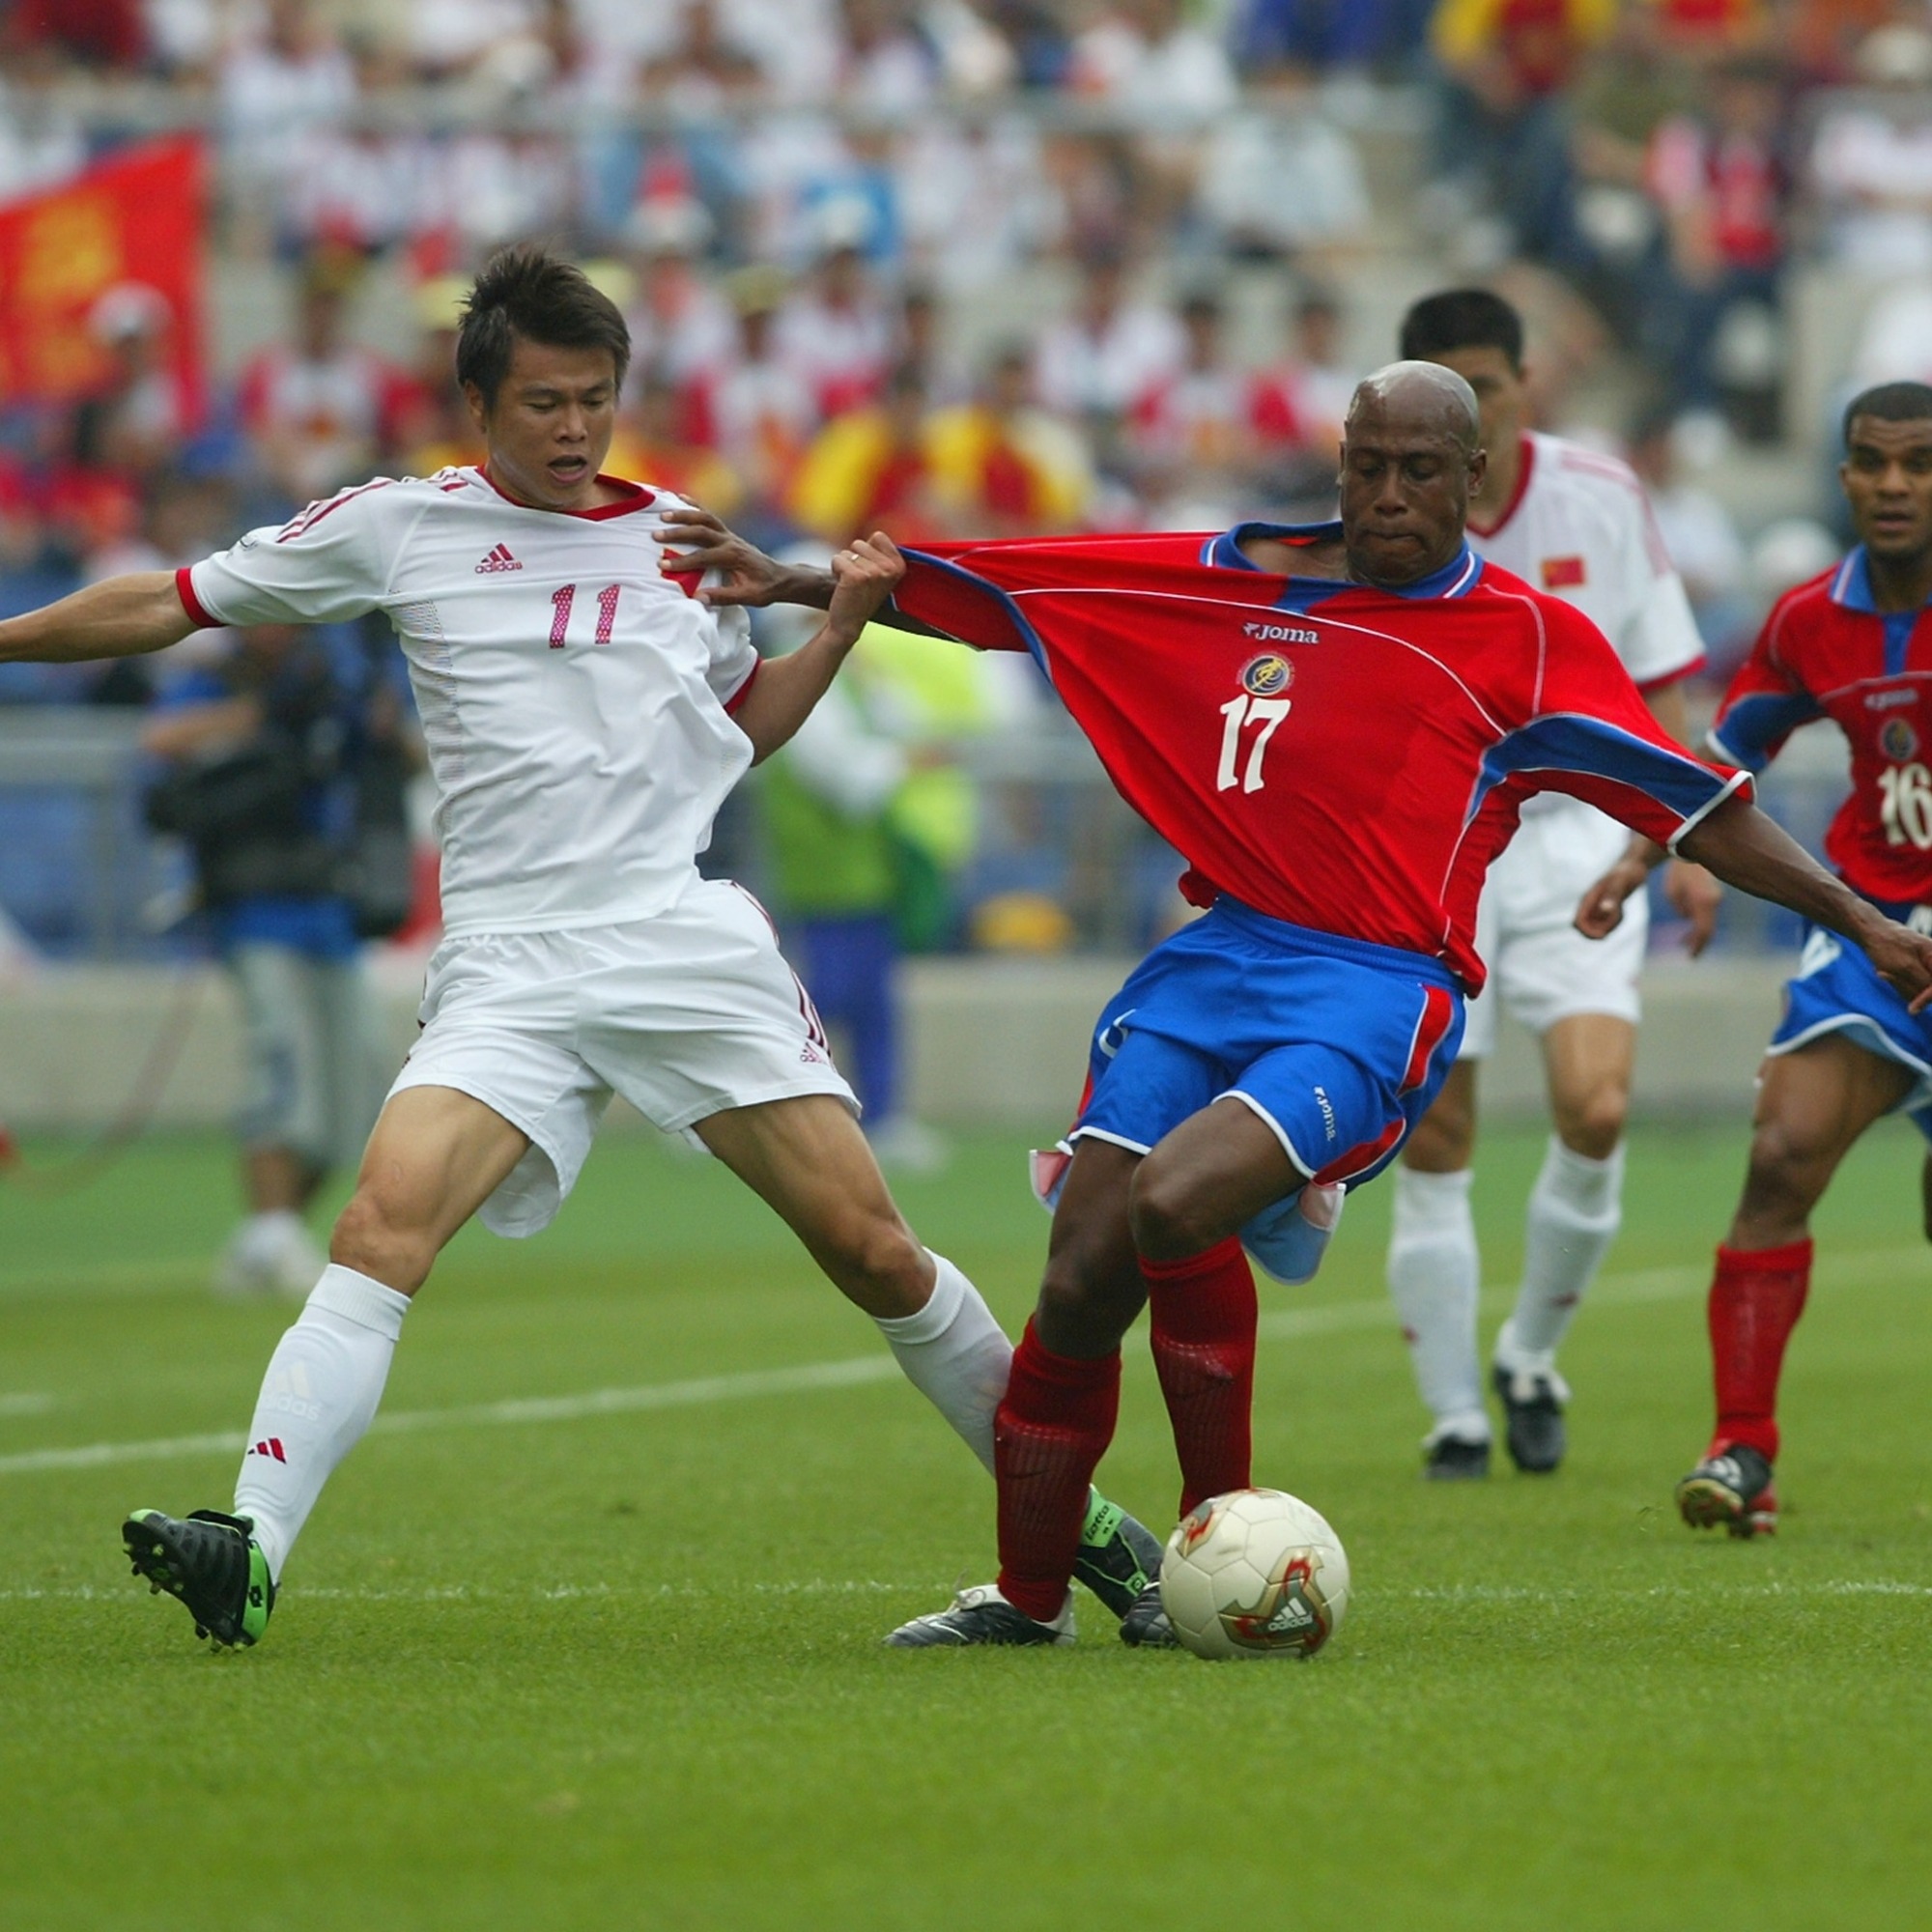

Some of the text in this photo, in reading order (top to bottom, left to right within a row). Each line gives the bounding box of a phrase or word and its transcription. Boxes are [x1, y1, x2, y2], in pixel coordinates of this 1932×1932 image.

[474, 559, 524, 574] adidas
[549, 583, 620, 648] 11
[1217, 694, 1292, 794] 17
[1877, 762, 1932, 849] 16
